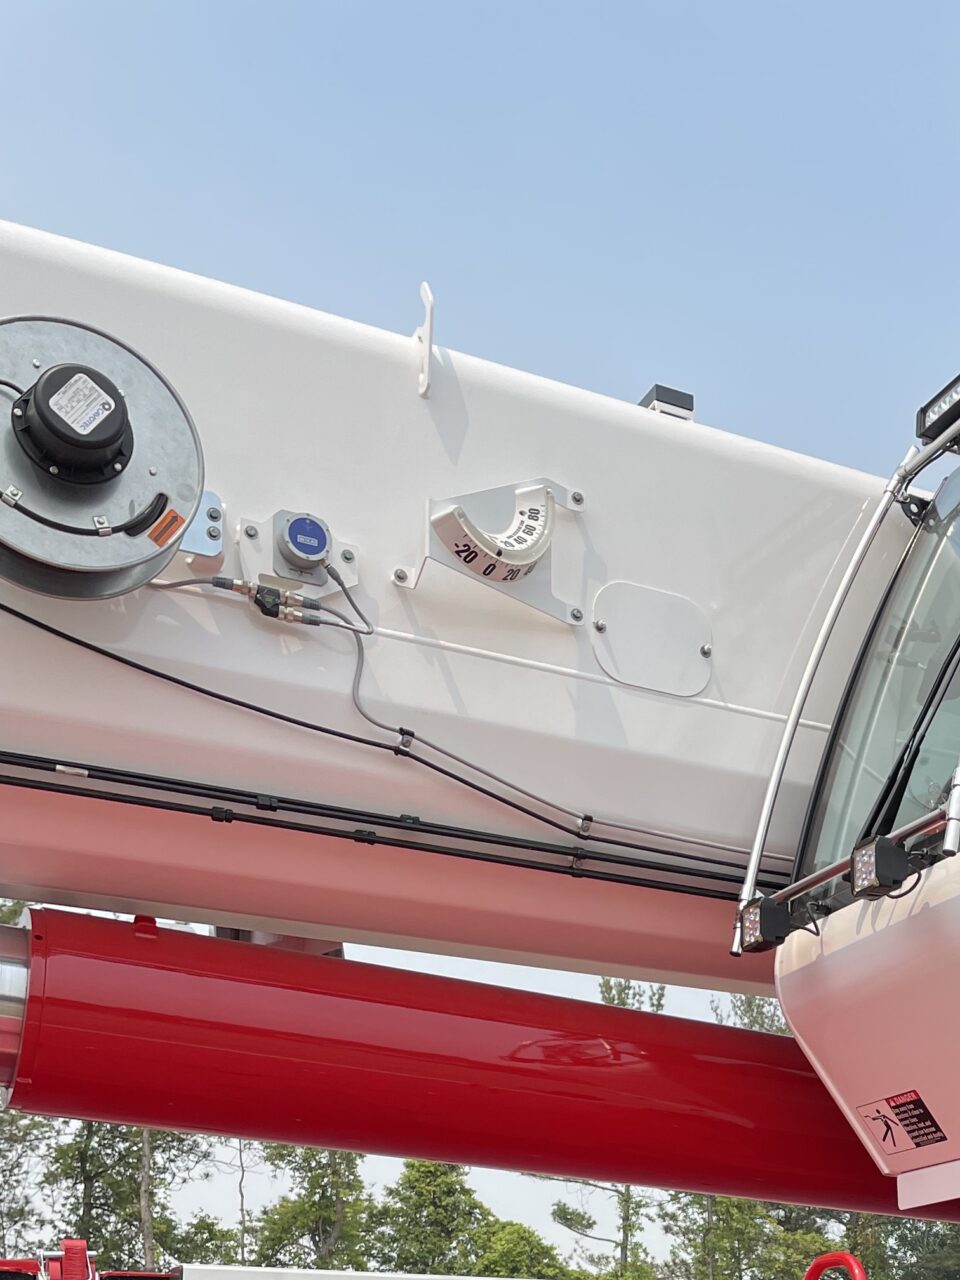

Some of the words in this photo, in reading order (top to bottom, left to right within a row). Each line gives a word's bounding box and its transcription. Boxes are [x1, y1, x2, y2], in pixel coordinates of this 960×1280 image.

[528, 507, 541, 521] 80
[522, 524, 537, 537] 60
[454, 543, 478, 564] -20
[482, 563, 497, 577] 0
[502, 568, 521, 581] 20
